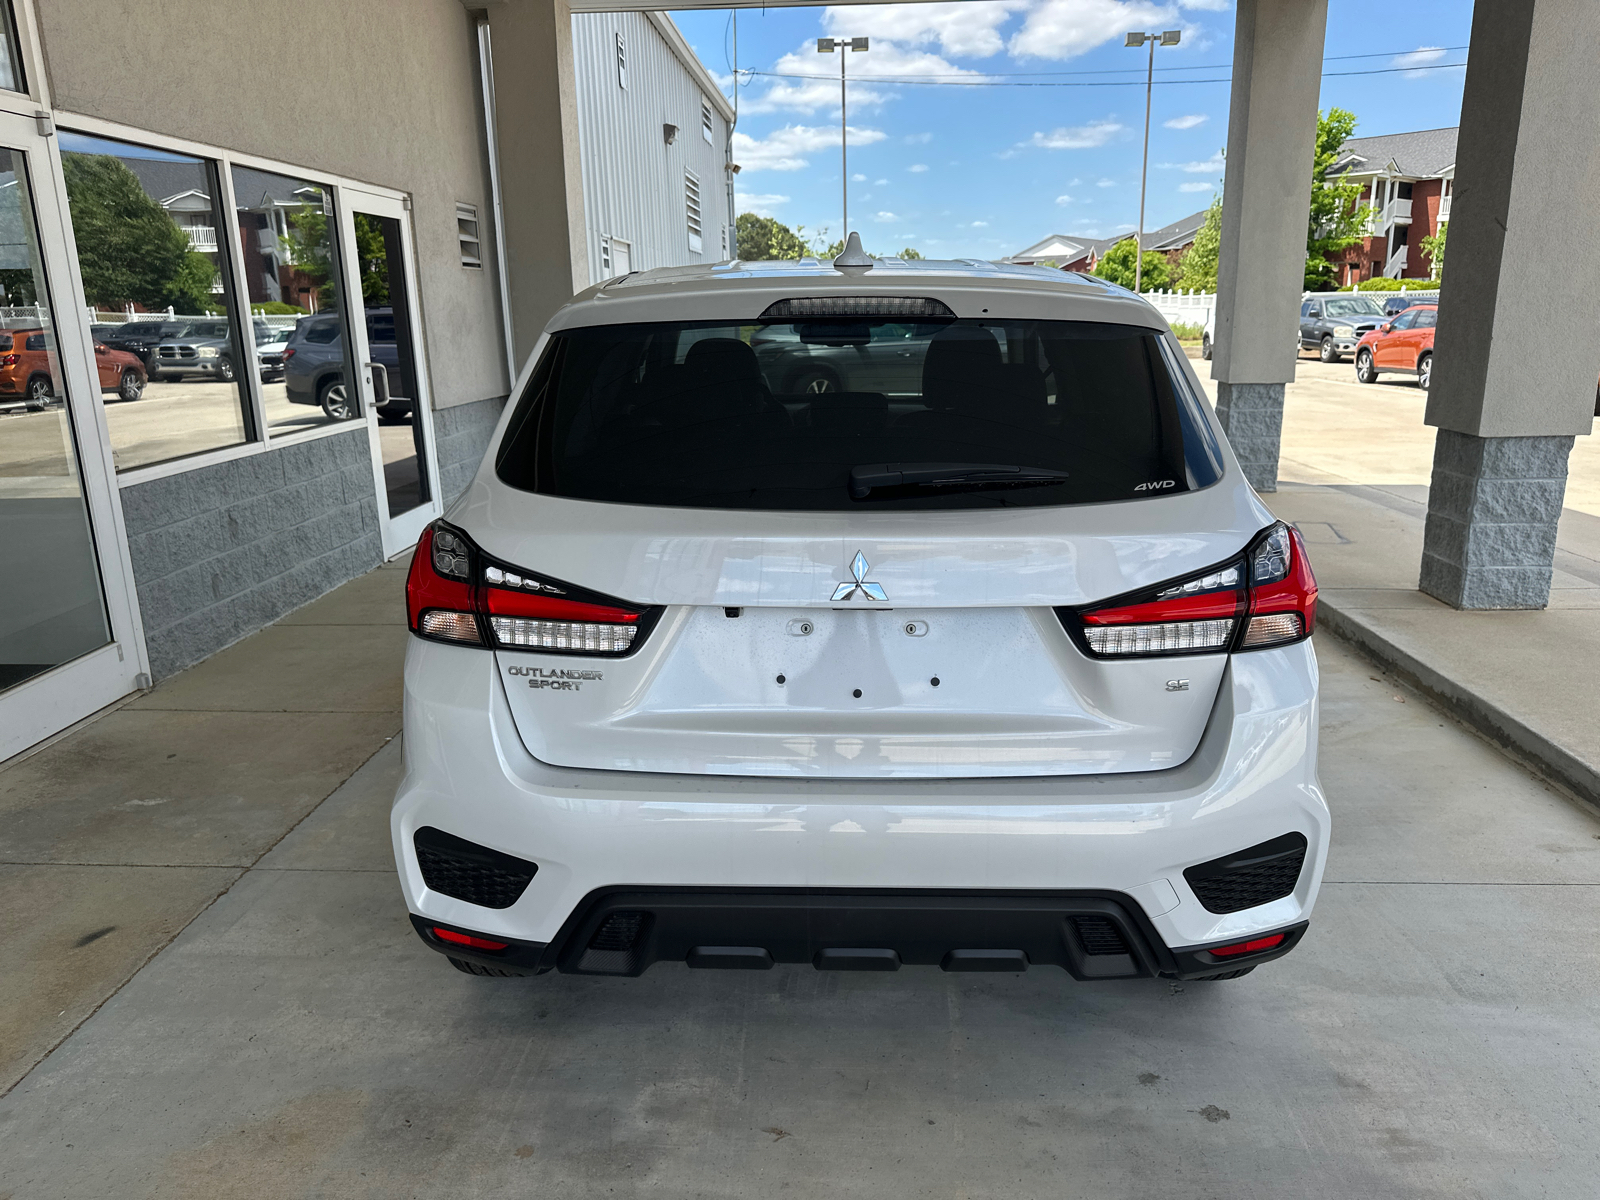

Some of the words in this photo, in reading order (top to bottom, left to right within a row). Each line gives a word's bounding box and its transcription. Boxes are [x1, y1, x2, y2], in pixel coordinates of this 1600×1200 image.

[1134, 480, 1175, 491] 4WD
[508, 665, 604, 681] OUTLANDER
[528, 679, 582, 691] SPORT
[1165, 679, 1190, 692] SE
